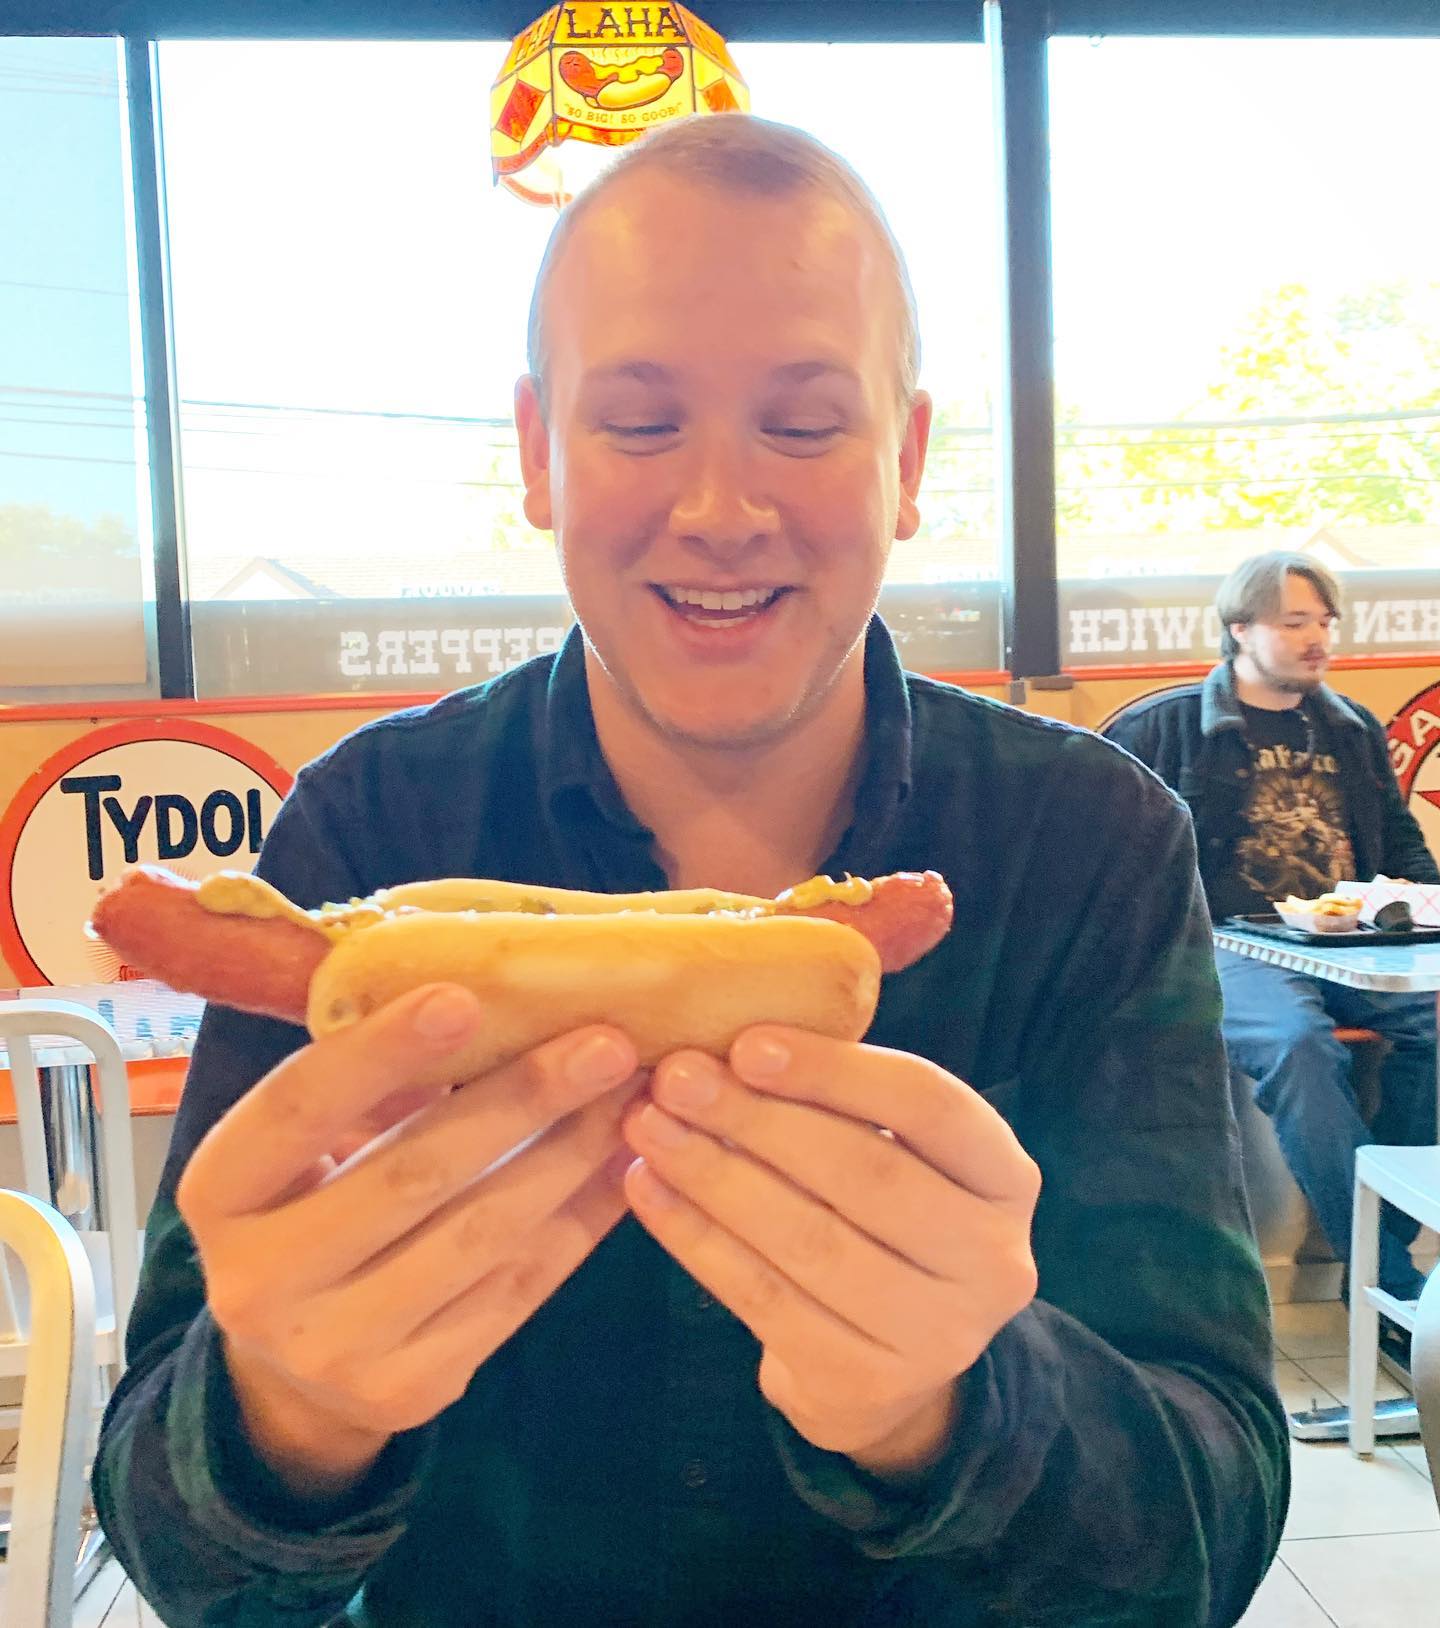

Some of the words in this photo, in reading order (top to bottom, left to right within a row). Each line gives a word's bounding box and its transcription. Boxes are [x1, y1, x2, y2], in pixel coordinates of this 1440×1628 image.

[565, 7, 686, 38] LAHA
[586, 111, 614, 124] BIG!
[621, 114, 637, 124] SO
